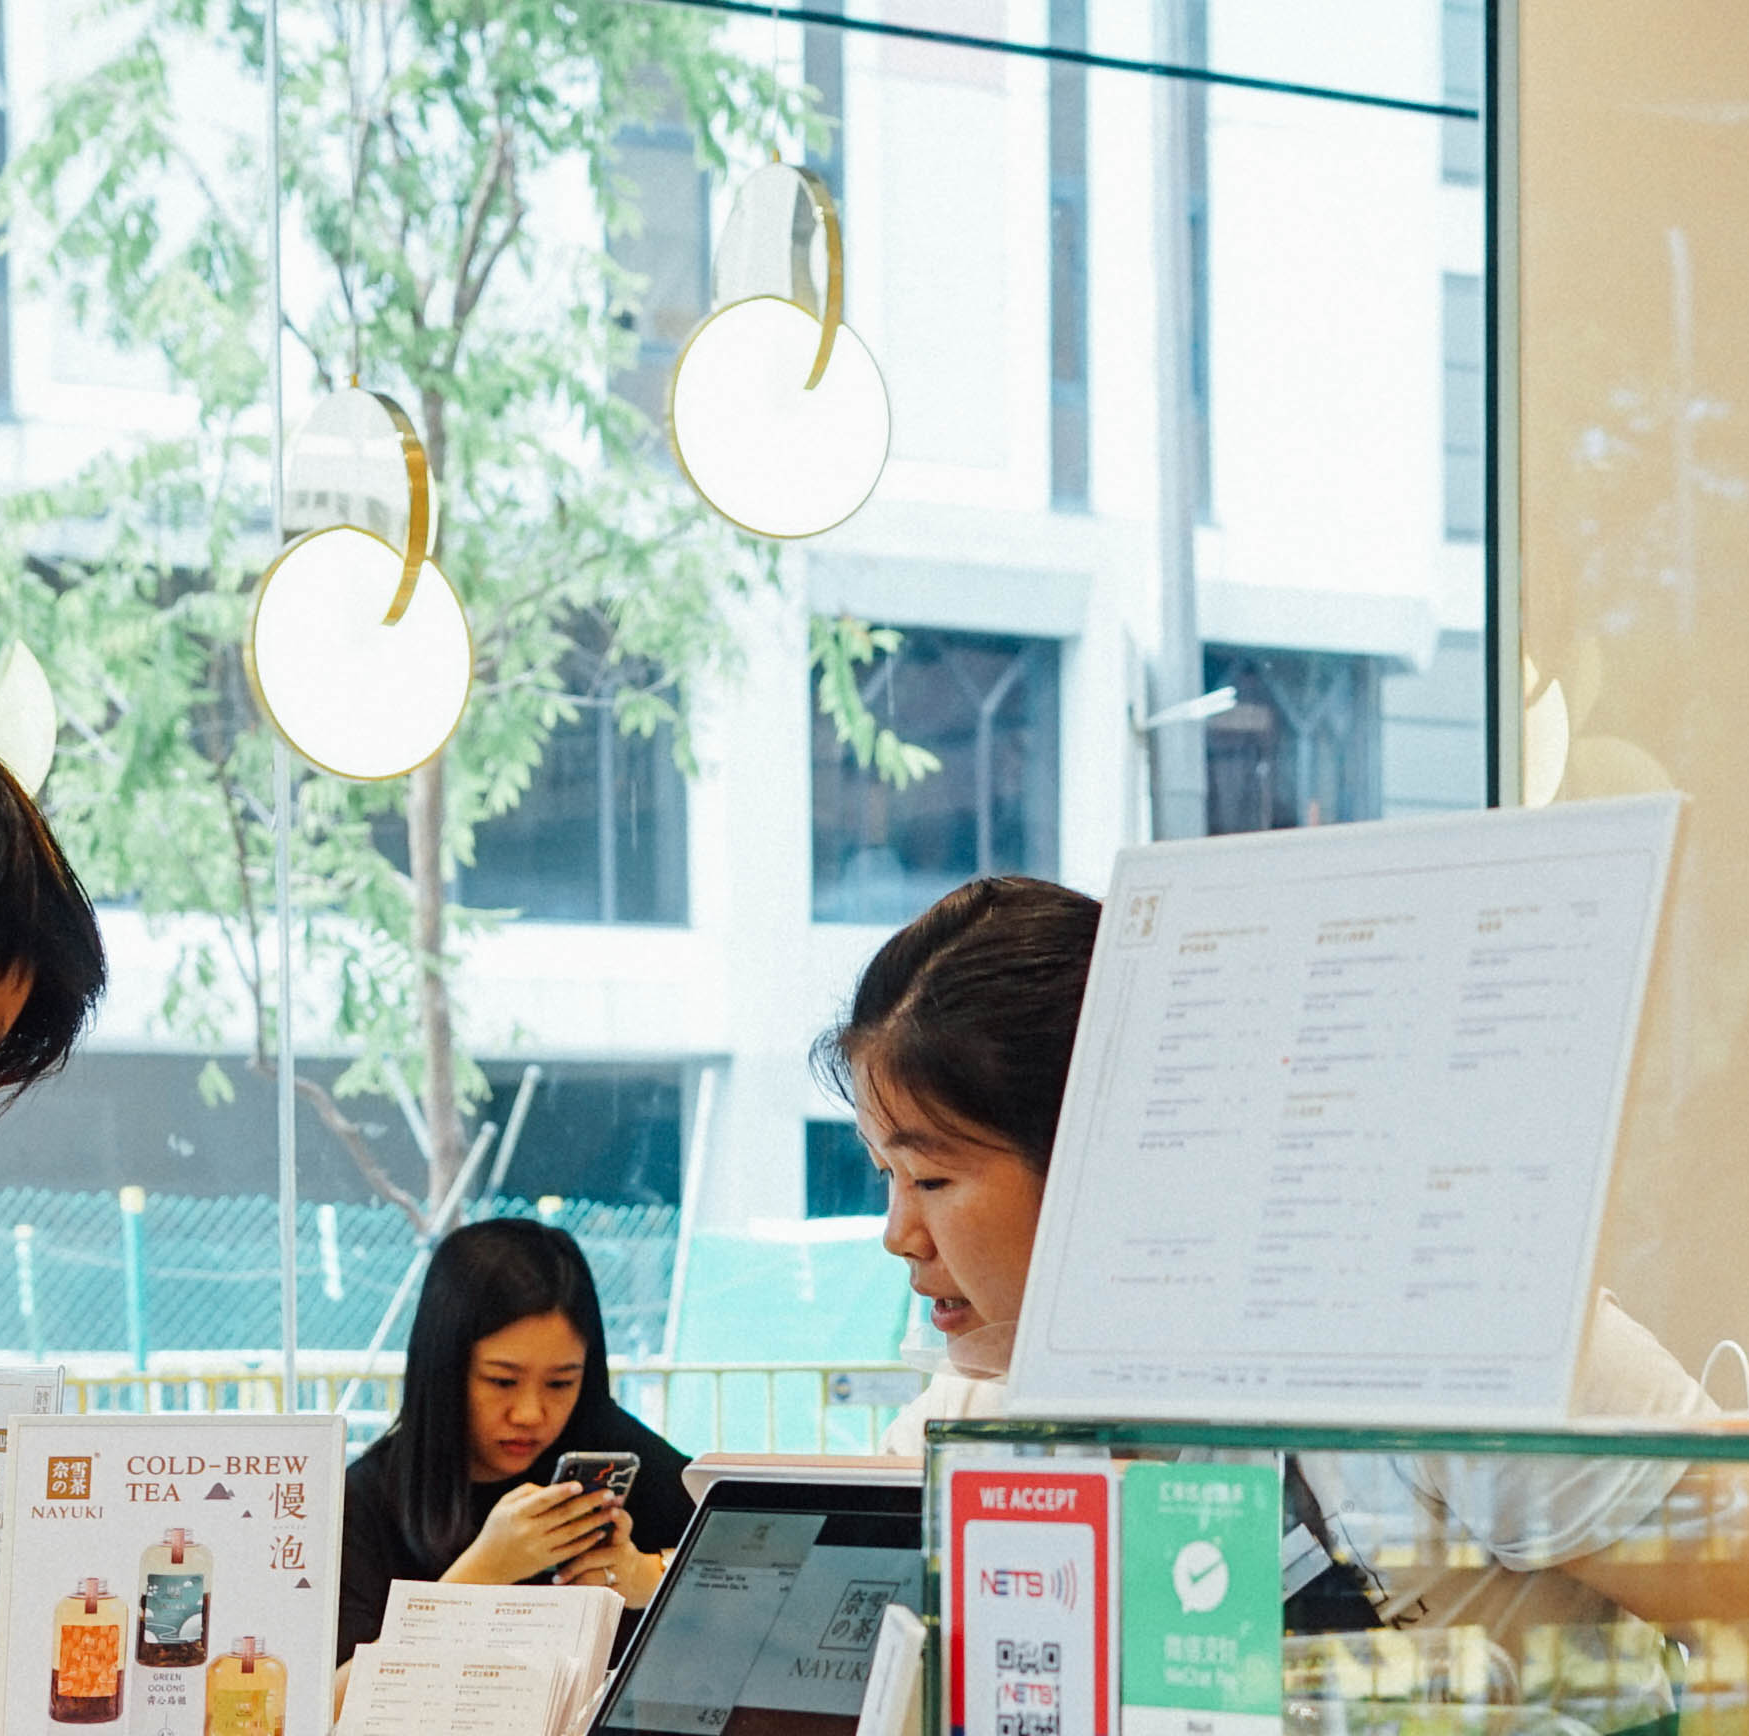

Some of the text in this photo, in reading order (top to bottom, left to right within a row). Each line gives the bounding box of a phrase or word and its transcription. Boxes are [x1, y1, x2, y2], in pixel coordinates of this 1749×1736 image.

[126, 1454, 310, 1477] COLD-BREW
[125, 1482, 182, 1503] TEA
[979, 1486, 1077, 1511] WE ACCEPT
[31, 1505, 104, 1520] NAYUKI
[981, 1569, 1043, 1598] NETS
[152, 1673, 182, 1682] GREEN
[789, 1657, 869, 1682] NAYUK
[147, 1684, 186, 1693] OOLONG
